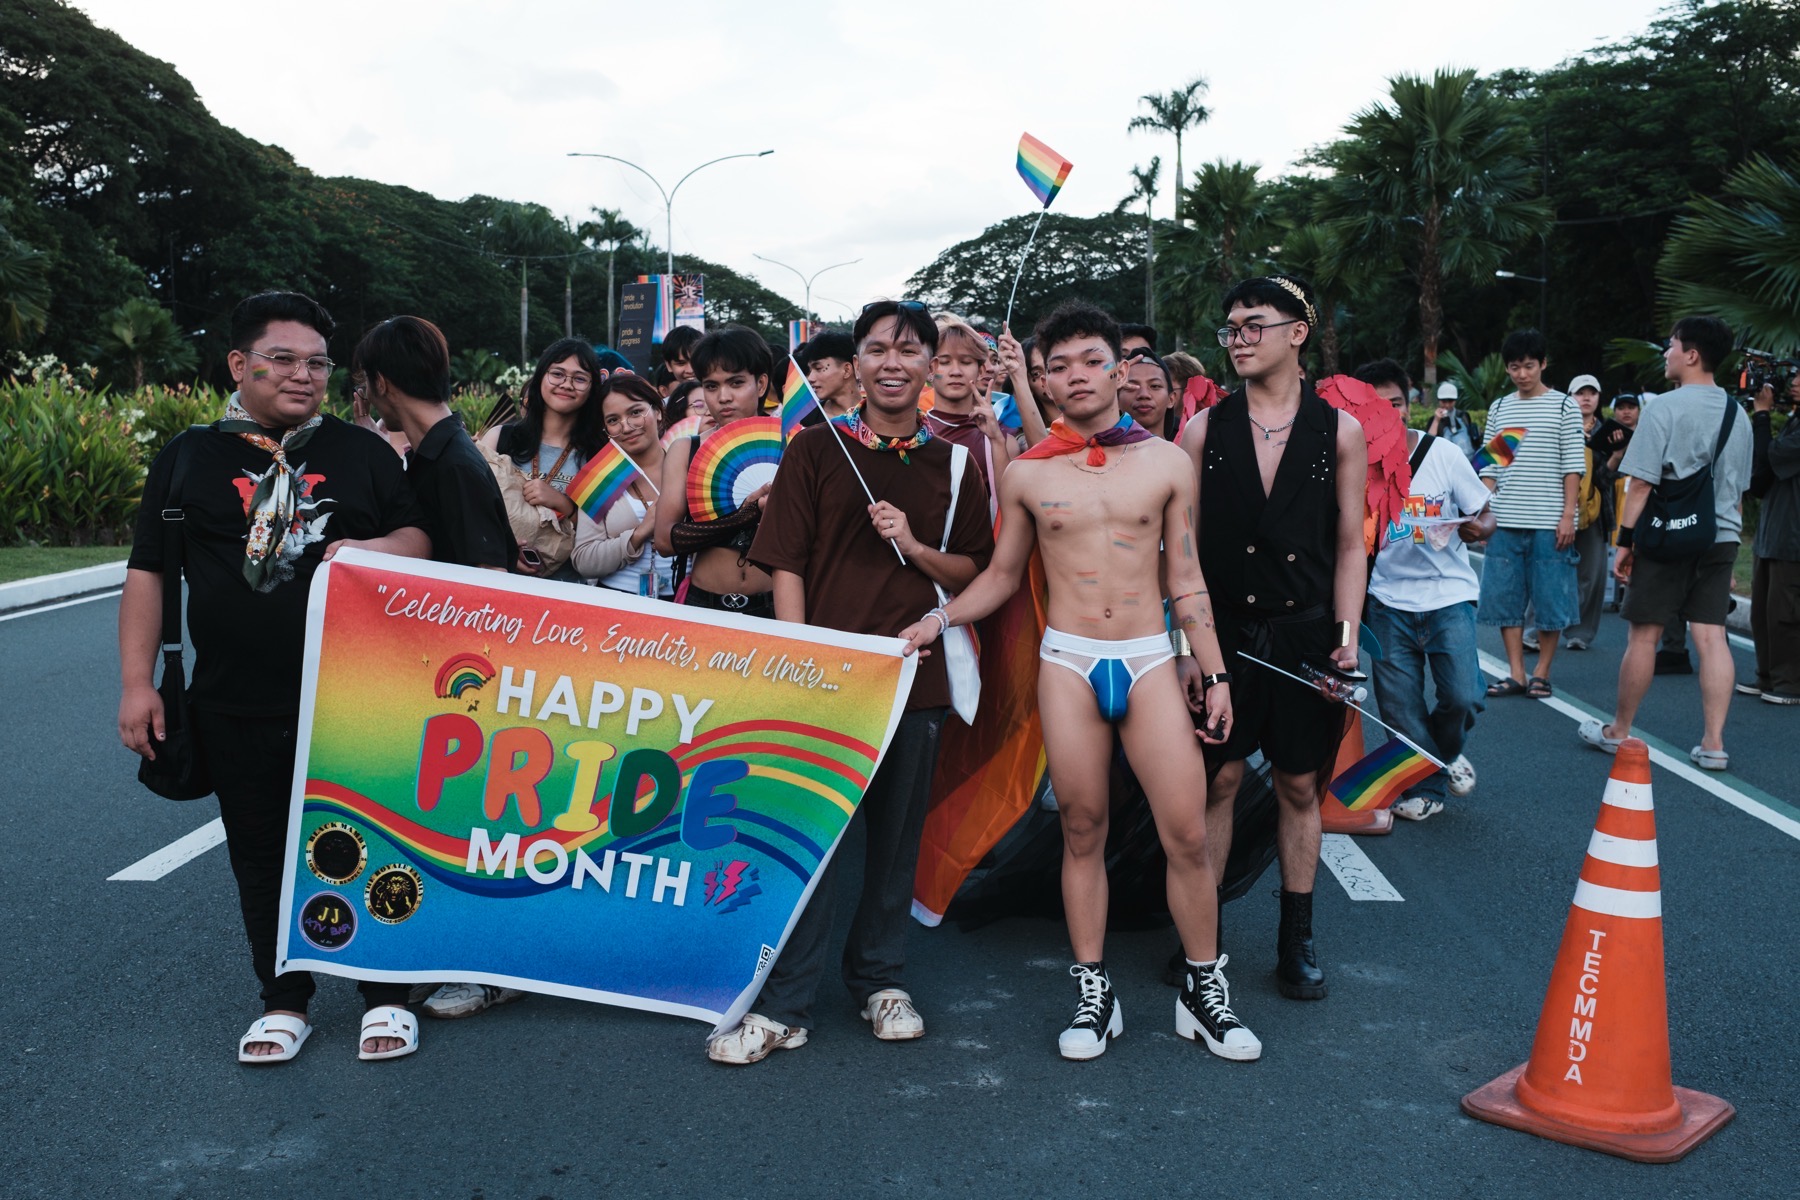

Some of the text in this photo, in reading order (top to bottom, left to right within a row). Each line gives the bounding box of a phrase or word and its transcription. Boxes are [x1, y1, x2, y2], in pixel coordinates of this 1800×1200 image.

[621, 338, 640, 346] progress
[377, 584, 526, 644] "Celebrating
[531, 610, 588, 653] Love,
[599, 623, 700, 671] Equality,
[708, 648, 758, 678] and
[496, 665, 716, 745] HAPPY
[415, 712, 750, 851] PRIDE
[308, 821, 367, 850] BLACK MAMBA
[465, 827, 692, 907] MONTH
[330, 923, 352, 936] BAR
